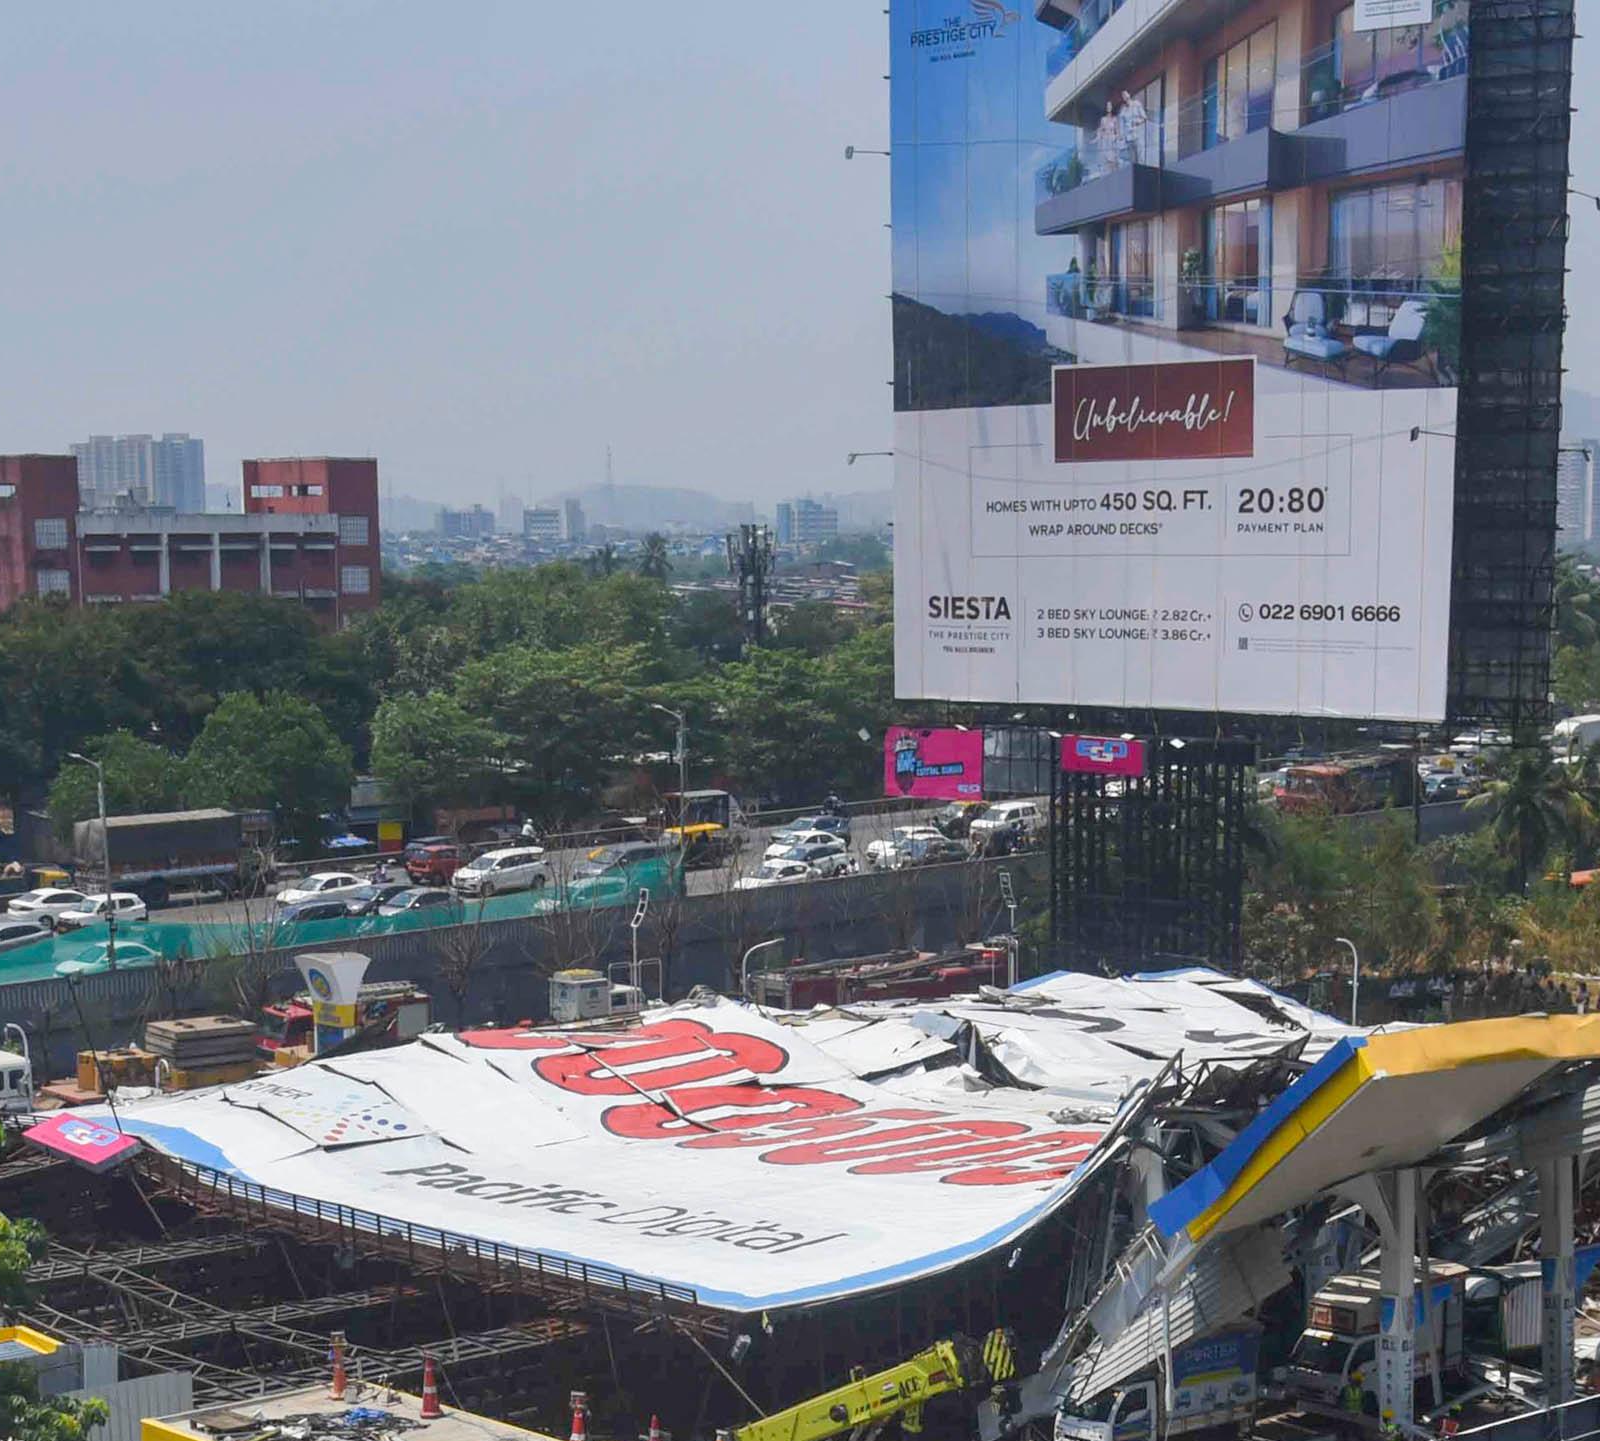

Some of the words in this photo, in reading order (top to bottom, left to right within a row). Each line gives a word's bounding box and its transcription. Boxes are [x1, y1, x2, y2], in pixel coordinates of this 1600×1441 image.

[944, 17, 961, 28] THE
[910, 28, 966, 48] PRESTIGE
[969, 21, 997, 39] CITY
[1072, 391, 1236, 441] Unbelievable!
[986, 500, 1027, 513] HOMES
[1031, 500, 1061, 512] WITH
[1064, 499, 1097, 511] UPTO
[1100, 492, 1137, 510] 450
[1142, 490, 1177, 511] SQ.
[1183, 489, 1212, 511] FT.
[1029, 524, 1063, 537] WRAP
[1067, 523, 1116, 536] AROUND
[1237, 522, 1289, 533] PAYMENT
[1294, 522, 1324, 533] PLAN
[928, 596, 1011, 620] SIESTA
[1037, 609, 1044, 620] 2
[1048, 609, 1070, 620] BED
[1074, 609, 1096, 621] SKY
[1099, 609, 1150, 621] LOUNGE:
[1161, 610, 1188, 621] 2.82
[1259, 604, 1294, 619] 022
[1300, 604, 1344, 620] 6901
[1351, 605, 1401, 622] 6666
[928, 630, 944, 640] THE
[948, 631, 987, 641] PRESTIGE
[991, 632, 1010, 641] CITY
[1037, 628, 1044, 638] 3
[1048, 628, 1070, 639] BED
[1074, 628, 1096, 639] SKY
[1099, 628, 1150, 640] LOUNGE:
[1161, 629, 1188, 641] 3.86
[381, 1163, 618, 1214] Pacific
[592, 1205, 850, 1254] Digital
